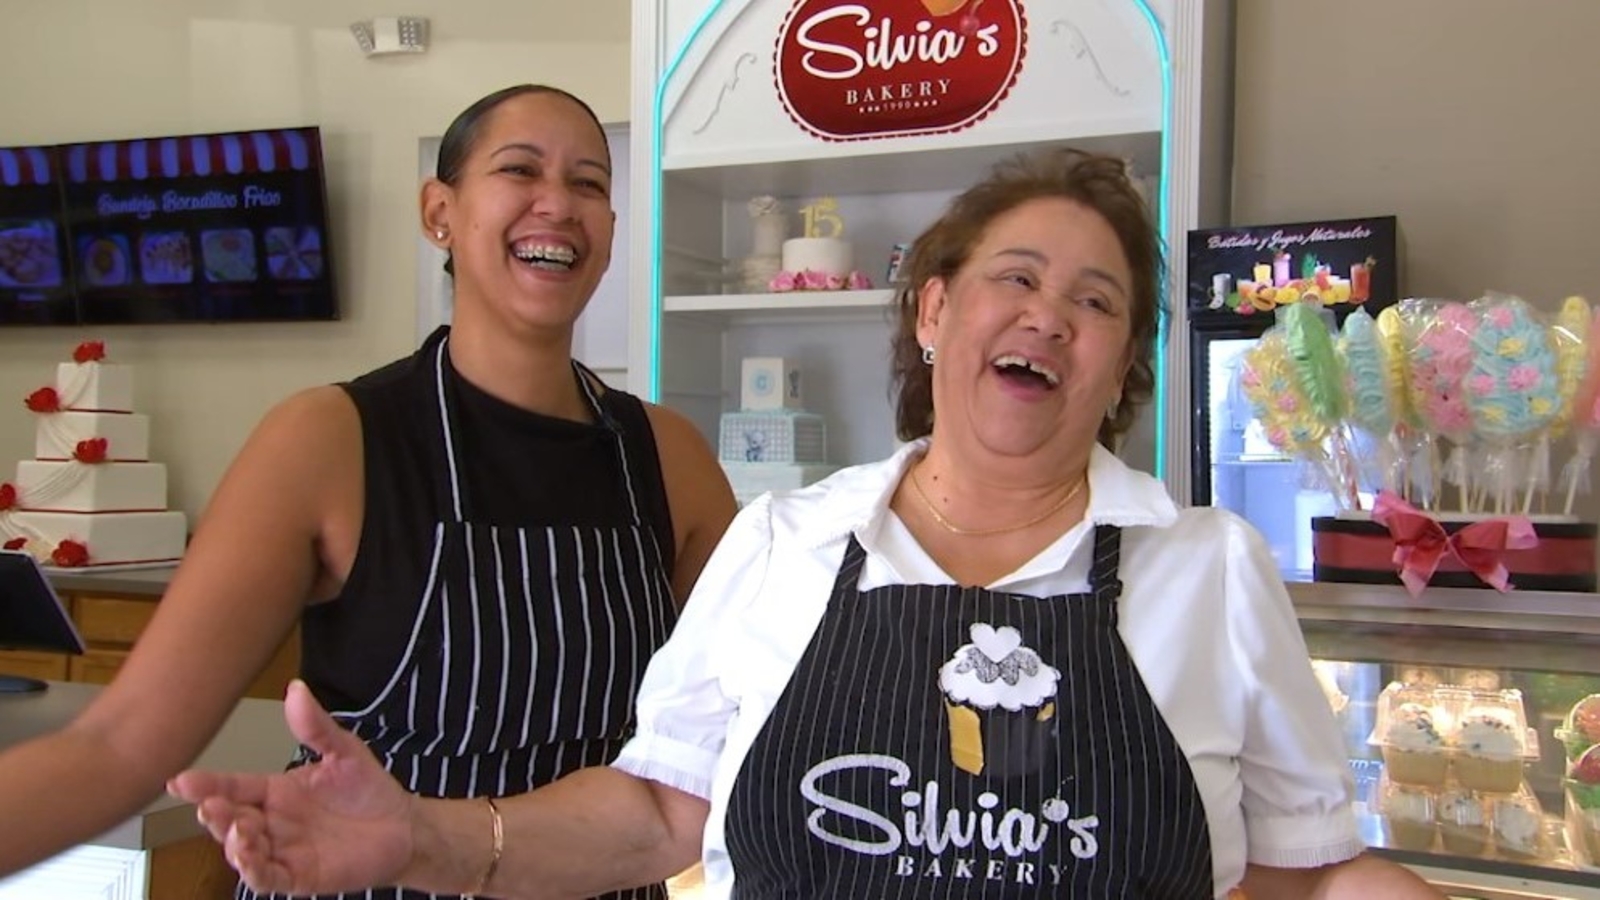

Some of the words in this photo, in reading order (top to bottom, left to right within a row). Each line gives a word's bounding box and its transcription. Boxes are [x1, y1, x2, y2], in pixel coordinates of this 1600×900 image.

[797, 5, 999, 79] Silvia's
[845, 78, 951, 105] BAKERY
[798, 205, 843, 239] 15
[1207, 233, 1259, 249] Batidos
[1256, 237, 1270, 251] y
[1267, 230, 1305, 249] Jugos
[1301, 226, 1372, 246] Naturales
[799, 753, 1099, 859] Silvia's
[895, 855, 1068, 886] BAKERY
